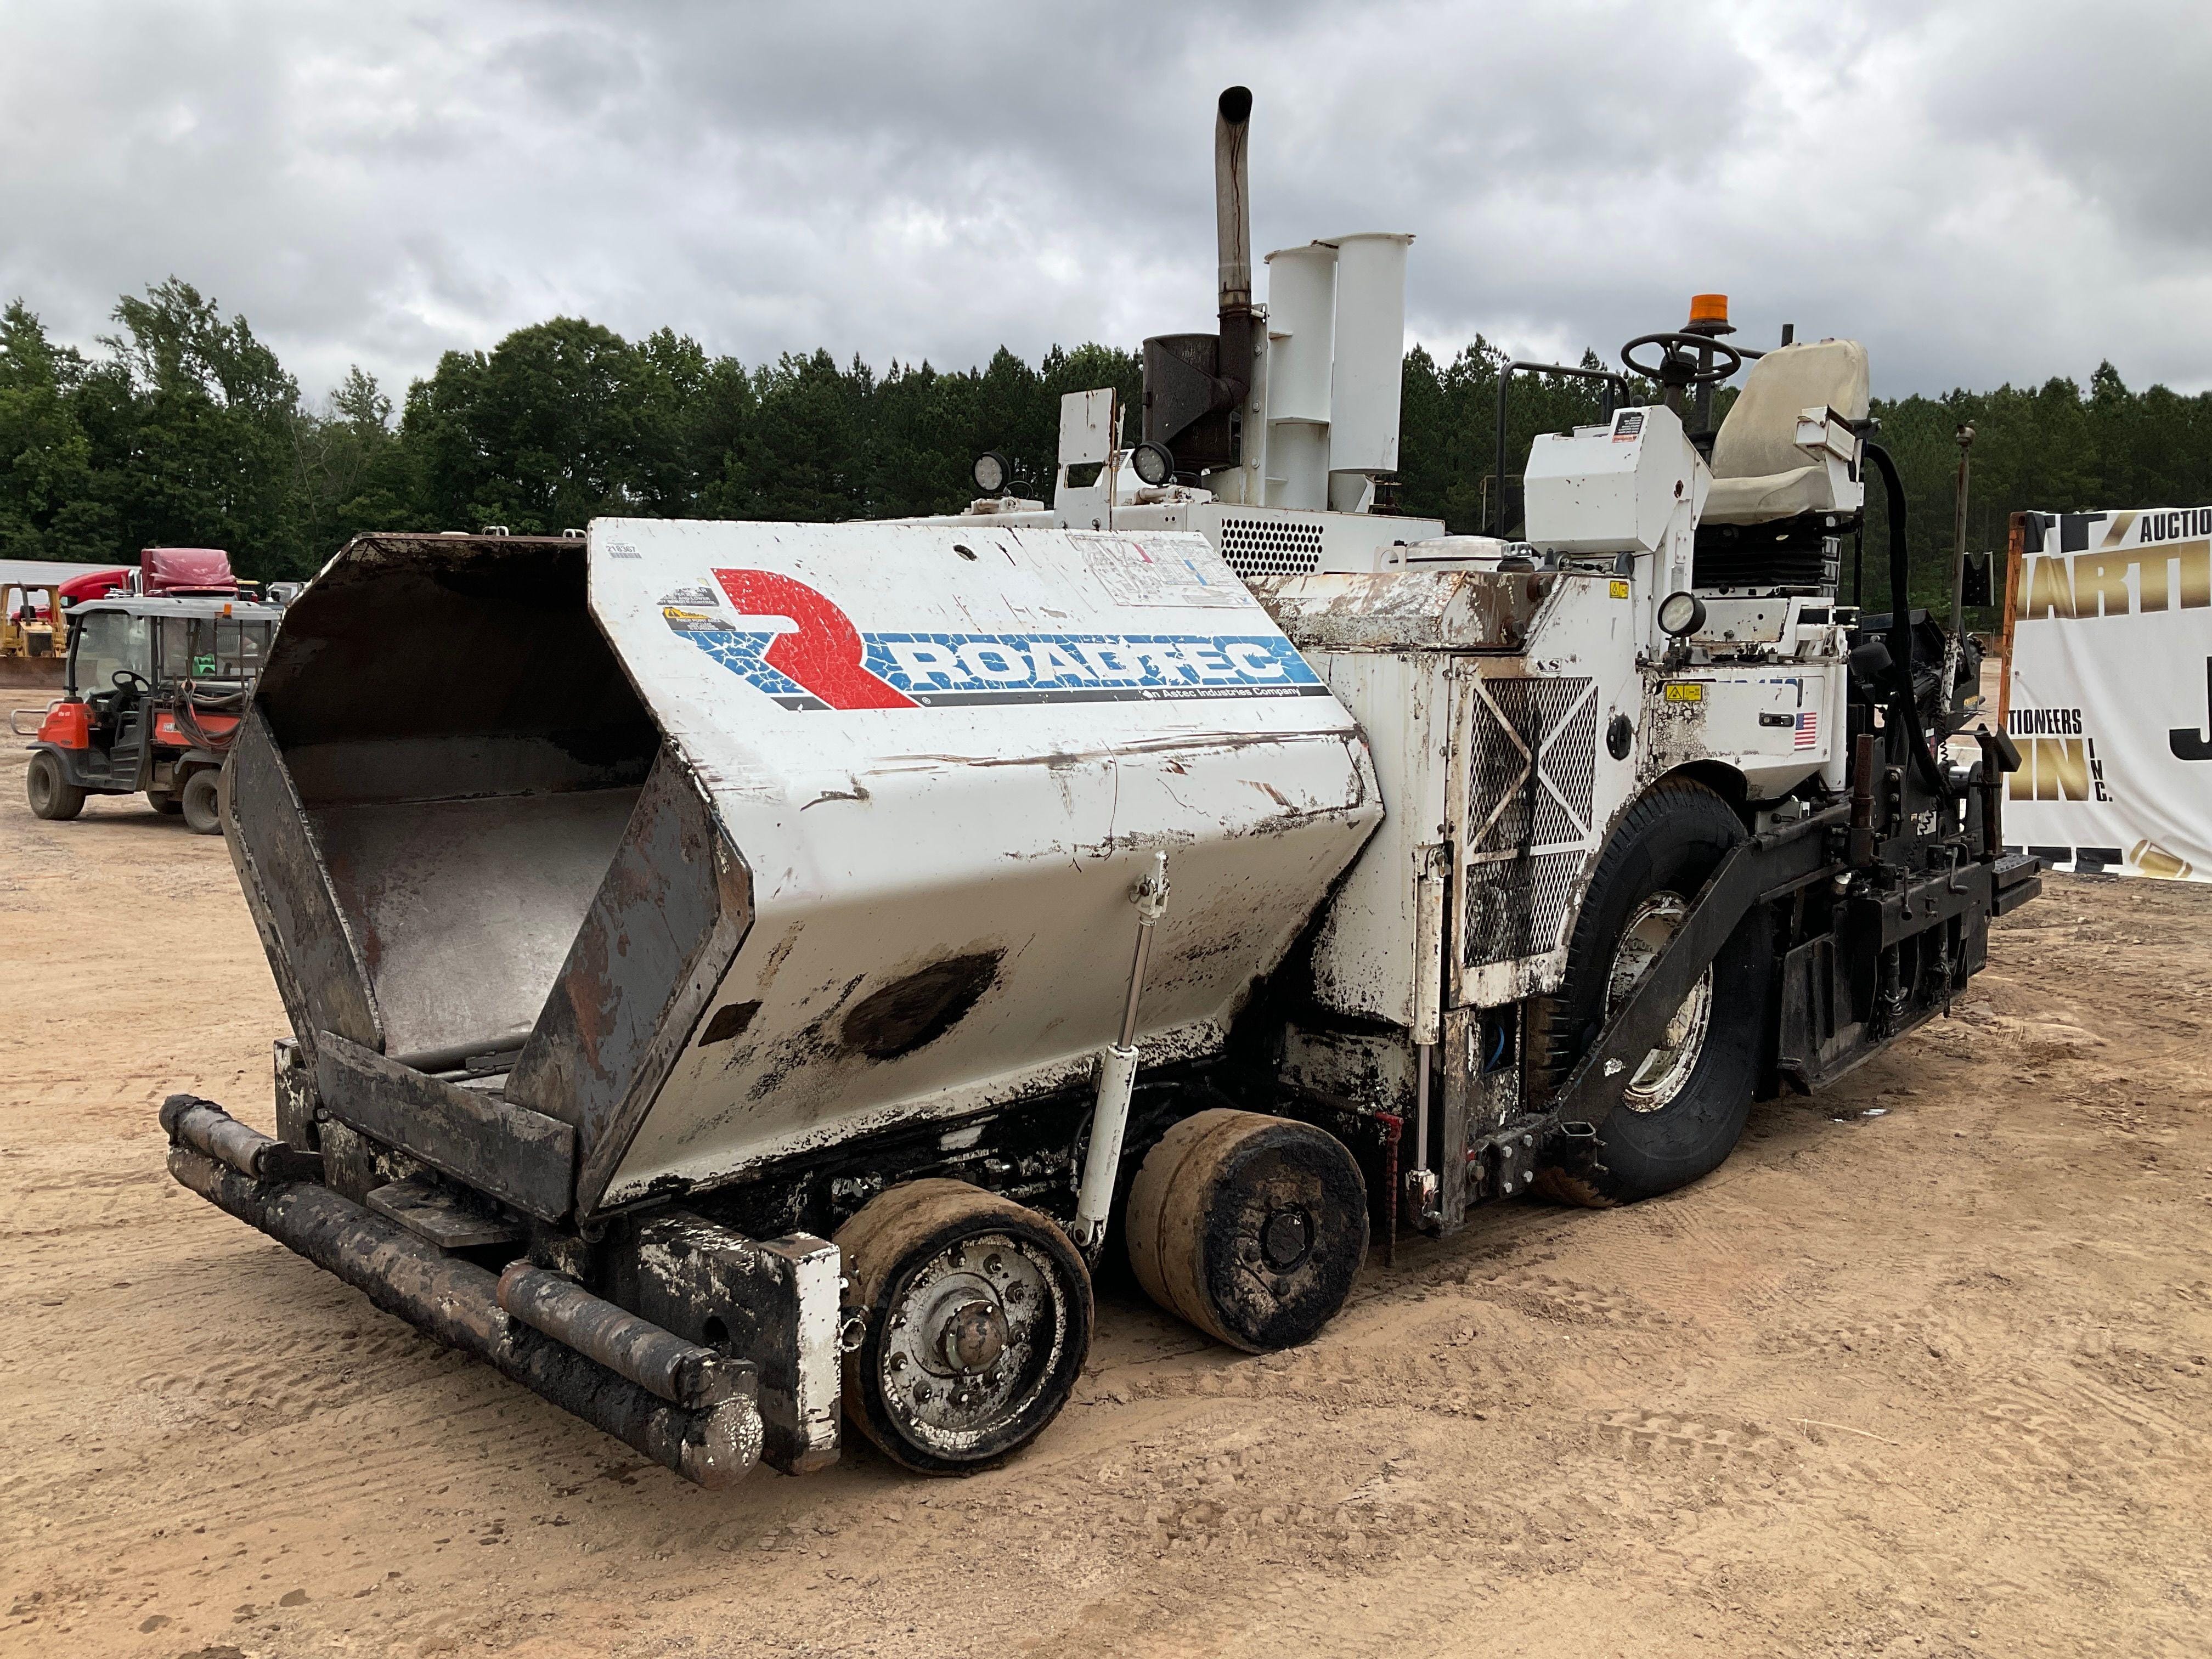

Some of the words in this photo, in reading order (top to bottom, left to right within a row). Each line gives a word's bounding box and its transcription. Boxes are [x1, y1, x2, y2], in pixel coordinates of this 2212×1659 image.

[888, 642, 1284, 682] ROADTEC
[1163, 689, 1196, 698] Astec
[1198, 687, 1252, 697] Industries
[1252, 686, 1301, 696] Company
[2008, 709, 2083, 735] TIONEERS
